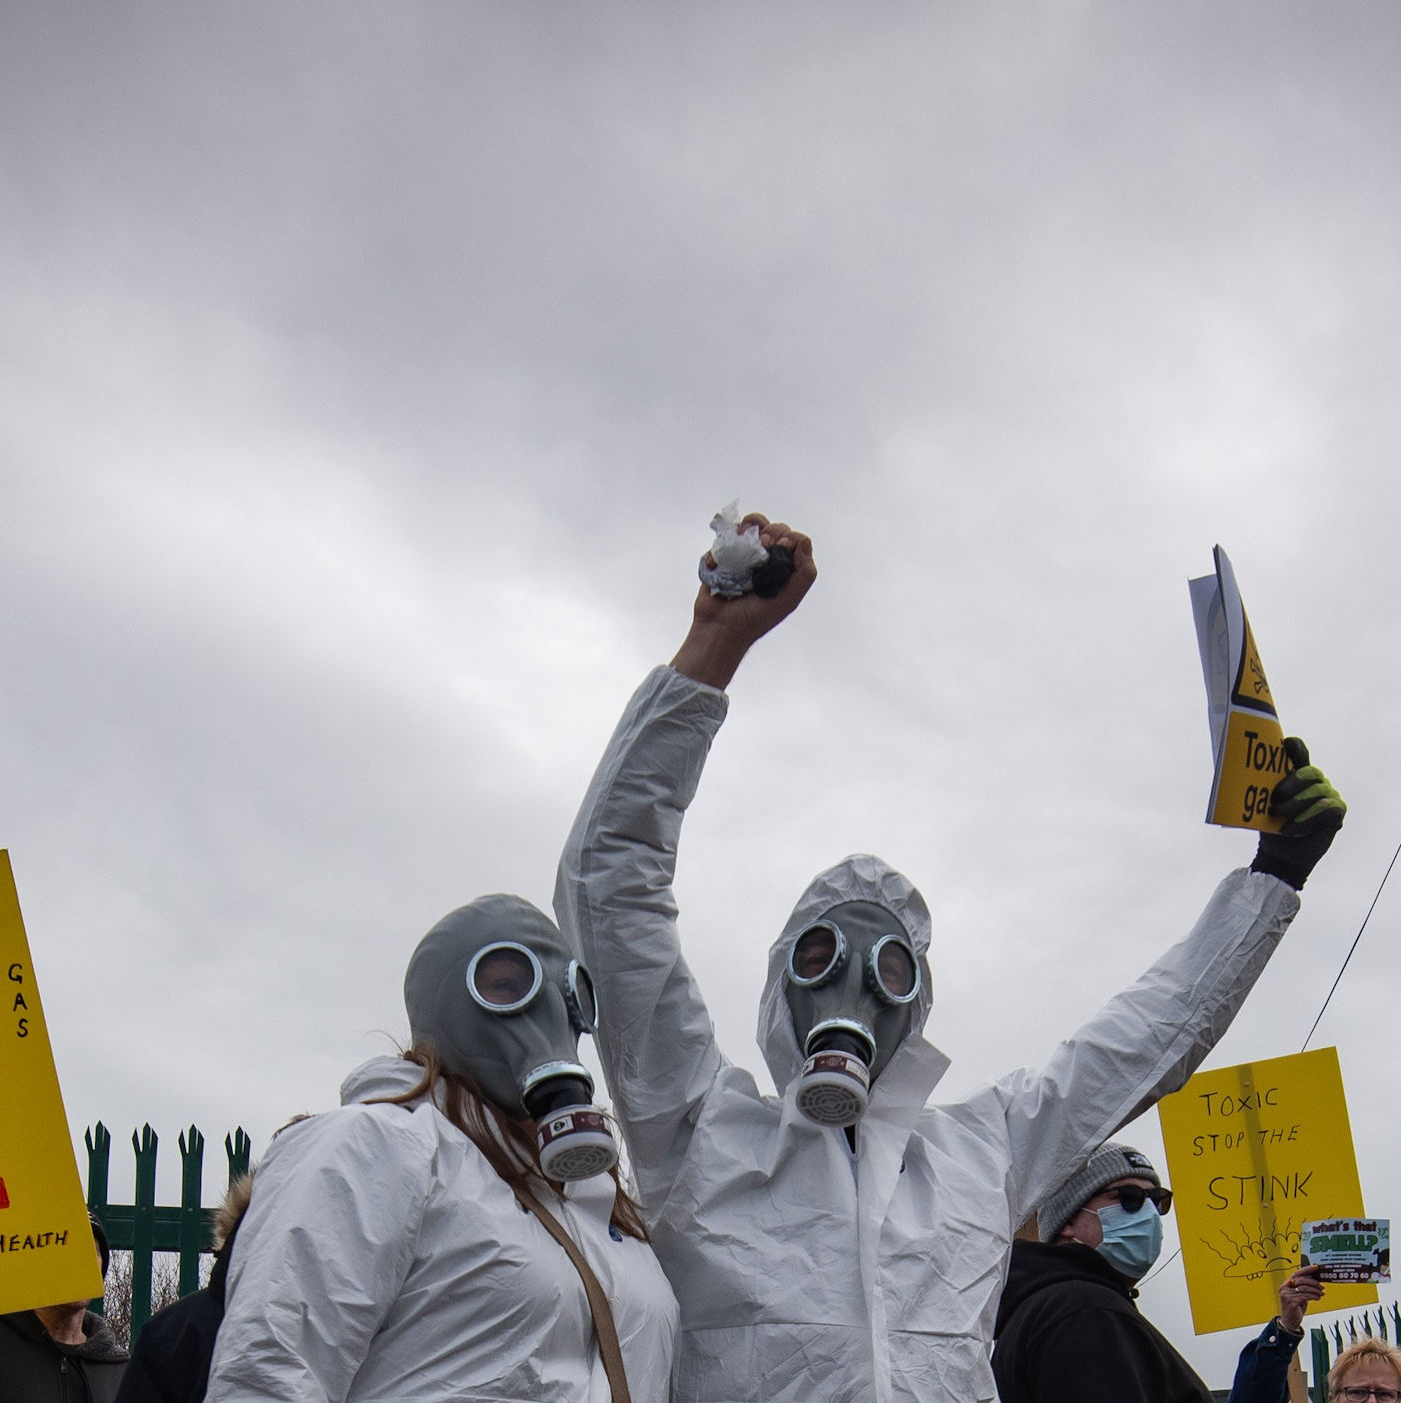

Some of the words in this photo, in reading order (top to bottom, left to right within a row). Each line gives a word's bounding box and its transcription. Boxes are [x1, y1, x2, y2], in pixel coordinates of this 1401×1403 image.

[7, 962, 30, 1039] GAS
[1199, 1088, 1279, 1117] TOXIC
[1192, 1131, 1245, 1157] STOP
[1257, 1124, 1301, 1146] THE
[1206, 1171, 1314, 1211] STINK
[1309, 1234, 1379, 1254] SMELL?
